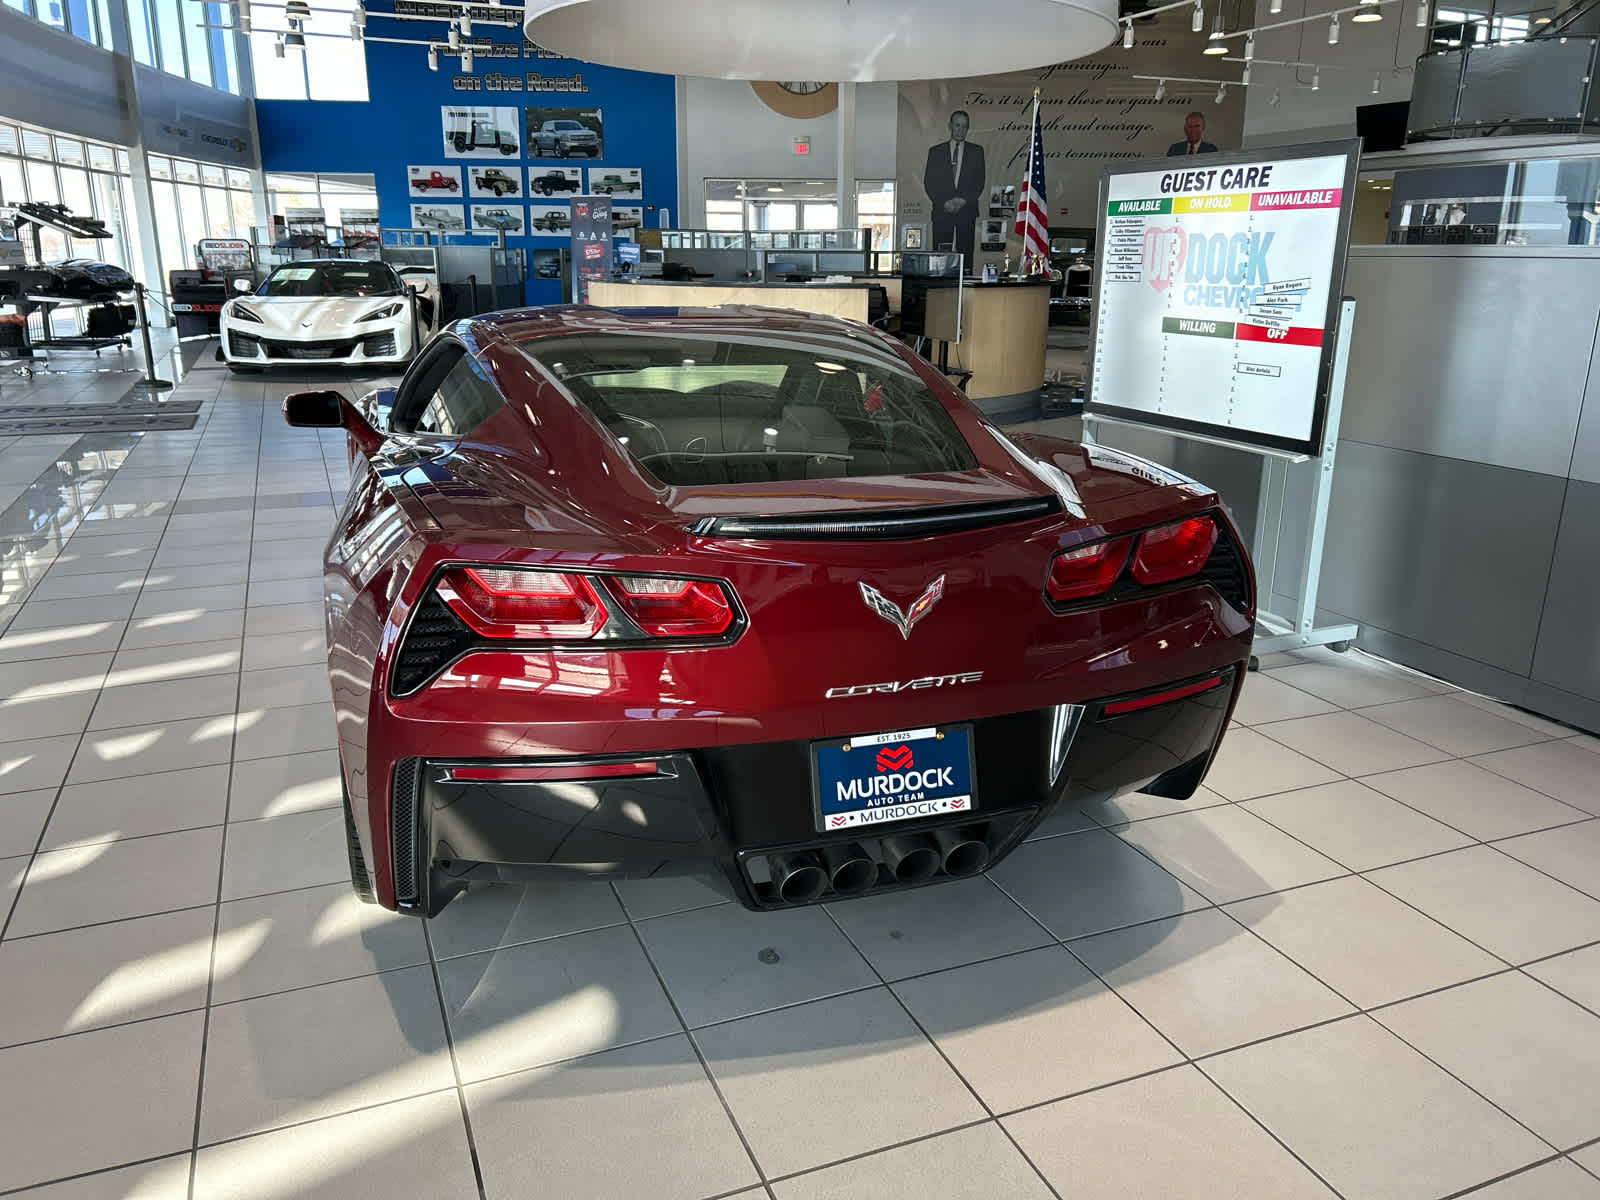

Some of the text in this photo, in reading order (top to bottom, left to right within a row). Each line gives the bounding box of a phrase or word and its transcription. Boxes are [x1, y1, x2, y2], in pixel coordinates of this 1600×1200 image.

[1141, 39, 1168, 47] our
[453, 72, 589, 93] on the Road.
[966, 87, 1192, 115] For it is fom there we gain our
[998, 114, 1061, 142] strenth
[1061, 115, 1093, 132] and
[1161, 166, 1273, 194] GUEST CARE
[1118, 200, 1162, 213] AVAILABLE
[1189, 196, 1231, 210] ON HOLD
[1258, 191, 1333, 206] UNAVAILABLE
[1179, 319, 1217, 333] WILLING
[1266, 328, 1288, 340] OFF
[825, 671, 985, 699] CORVETTE
[877, 732, 912, 743] EST. 1925
[836, 766, 954, 801] MURDOCK
[867, 791, 925, 807] AUTO TEAM
[860, 801, 939, 823] MURDOCK
